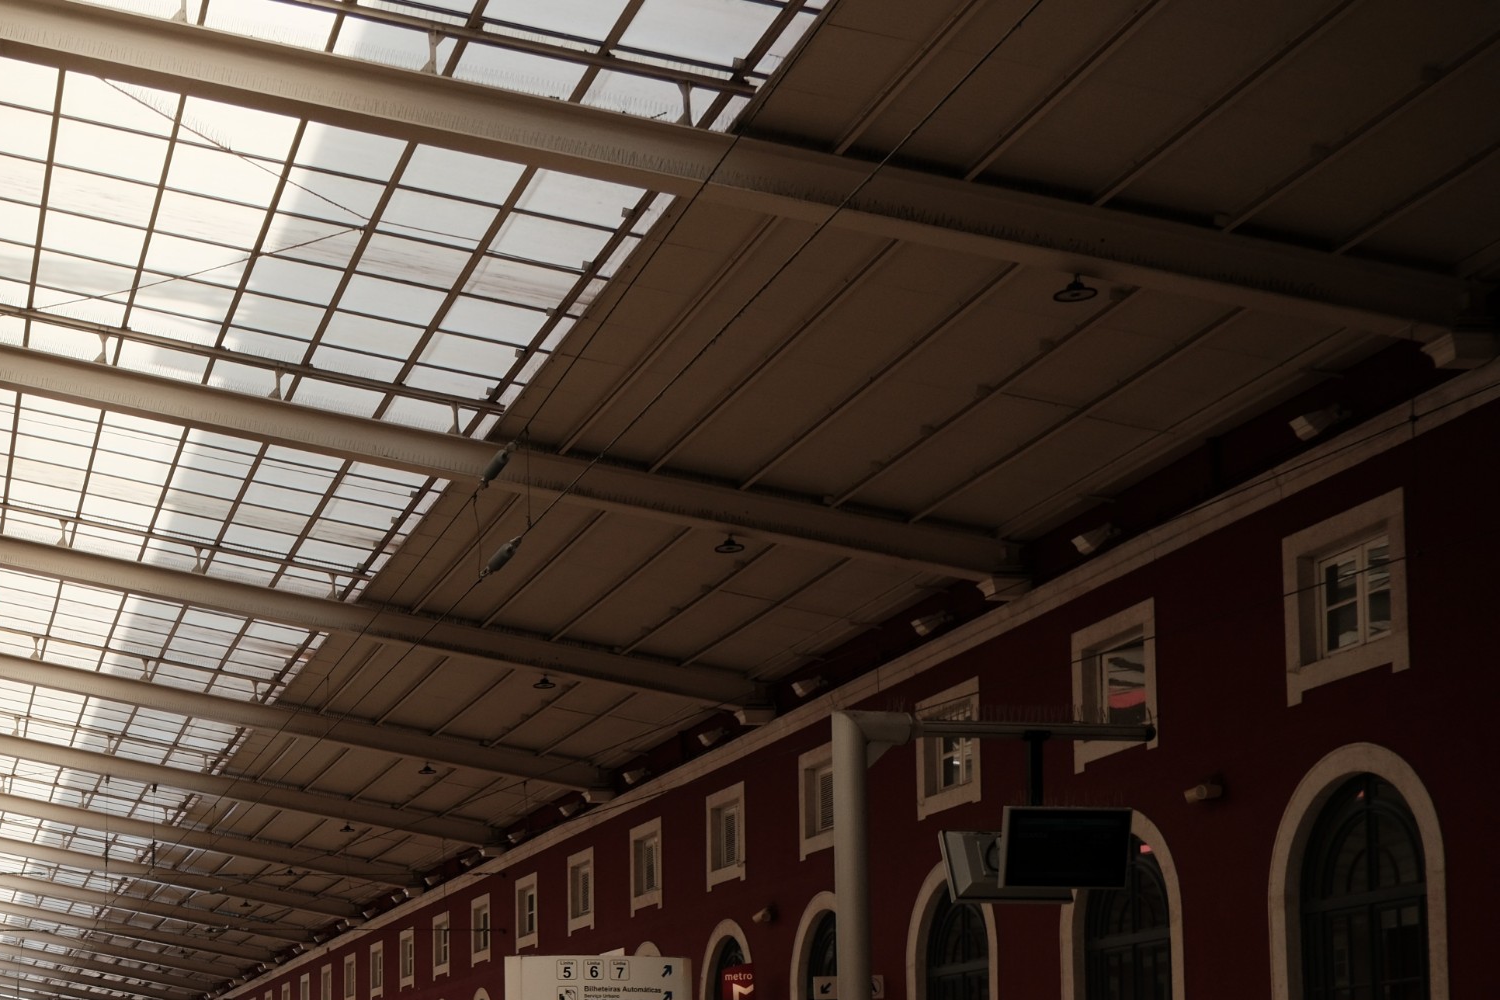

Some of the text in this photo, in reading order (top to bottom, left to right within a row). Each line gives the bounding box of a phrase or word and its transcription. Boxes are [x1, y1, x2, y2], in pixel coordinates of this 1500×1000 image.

[563, 967, 571, 978] 5
[590, 966, 599, 978] 6
[616, 968, 624, 978] 7
[724, 972, 753, 981] metro
